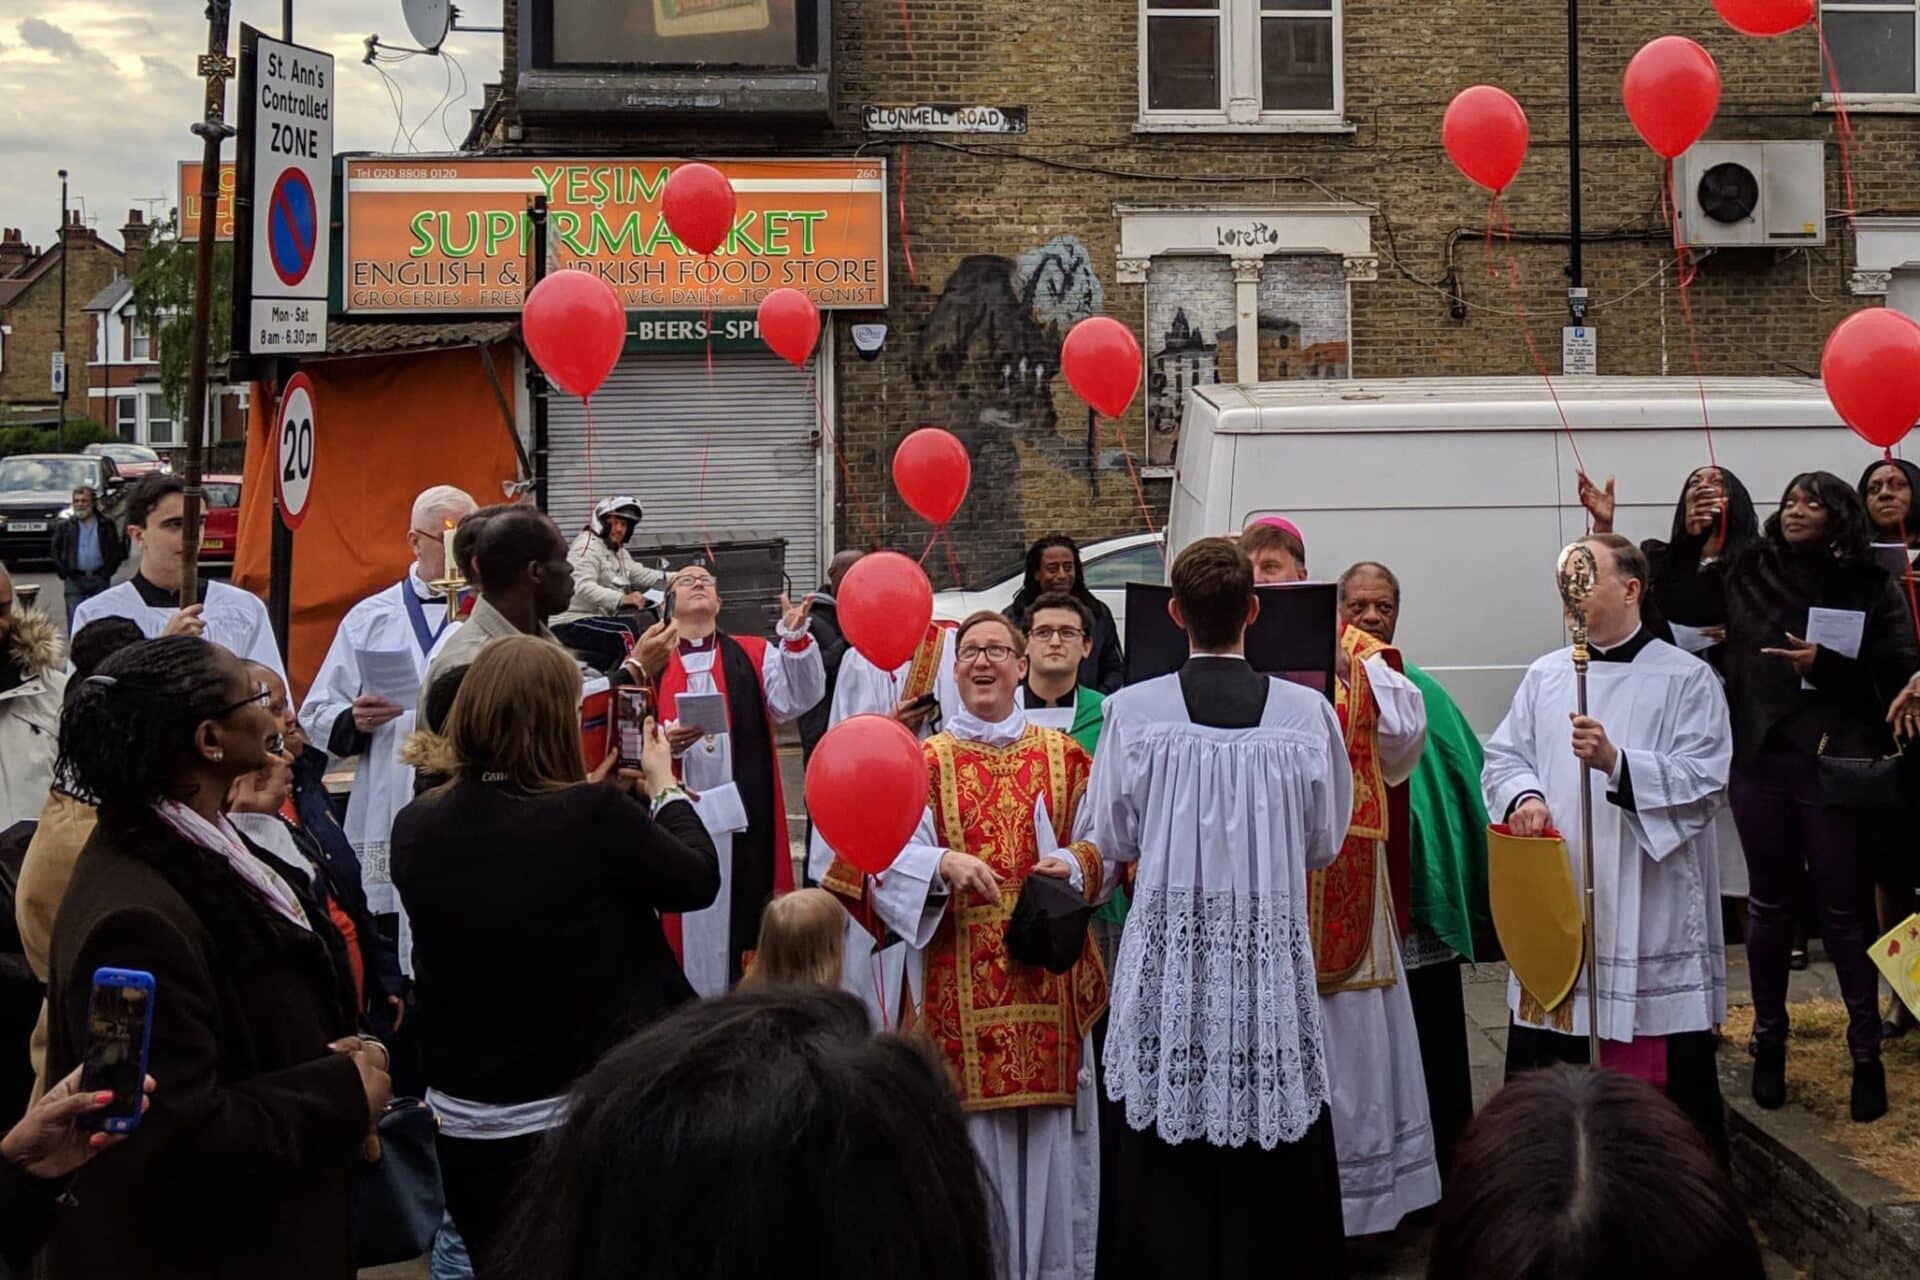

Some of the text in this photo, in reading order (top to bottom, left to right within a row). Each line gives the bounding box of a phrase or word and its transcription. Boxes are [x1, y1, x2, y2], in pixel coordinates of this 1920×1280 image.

[268, 52, 324, 88] St. Ann's
[262, 84, 328, 120] Controlled
[868, 107, 949, 125] CLONMELL
[957, 110, 999, 126] ROAD
[271, 122, 317, 159] ZONE
[355, 168, 371, 178] Tel
[374, 168, 396, 178] 020
[430, 168, 457, 178] 0120
[857, 169, 877, 178] 260
[409, 210, 827, 257] SUPRMAKET
[1217, 222, 1278, 247] Loretto
[354, 262, 486, 286] ENGLISH
[498, 262, 521, 286] &
[679, 261, 771, 284] FOOD
[783, 260, 877, 284] STORE
[353, 291, 460, 305] GROCERIES
[480, 290, 522, 305] FRES
[627, 290, 664, 304] VEG
[672, 289, 721, 304] DAILY
[272, 307, 289, 322] Mon
[296, 307, 309, 322] Sat
[283, 418, 312, 482] 20
